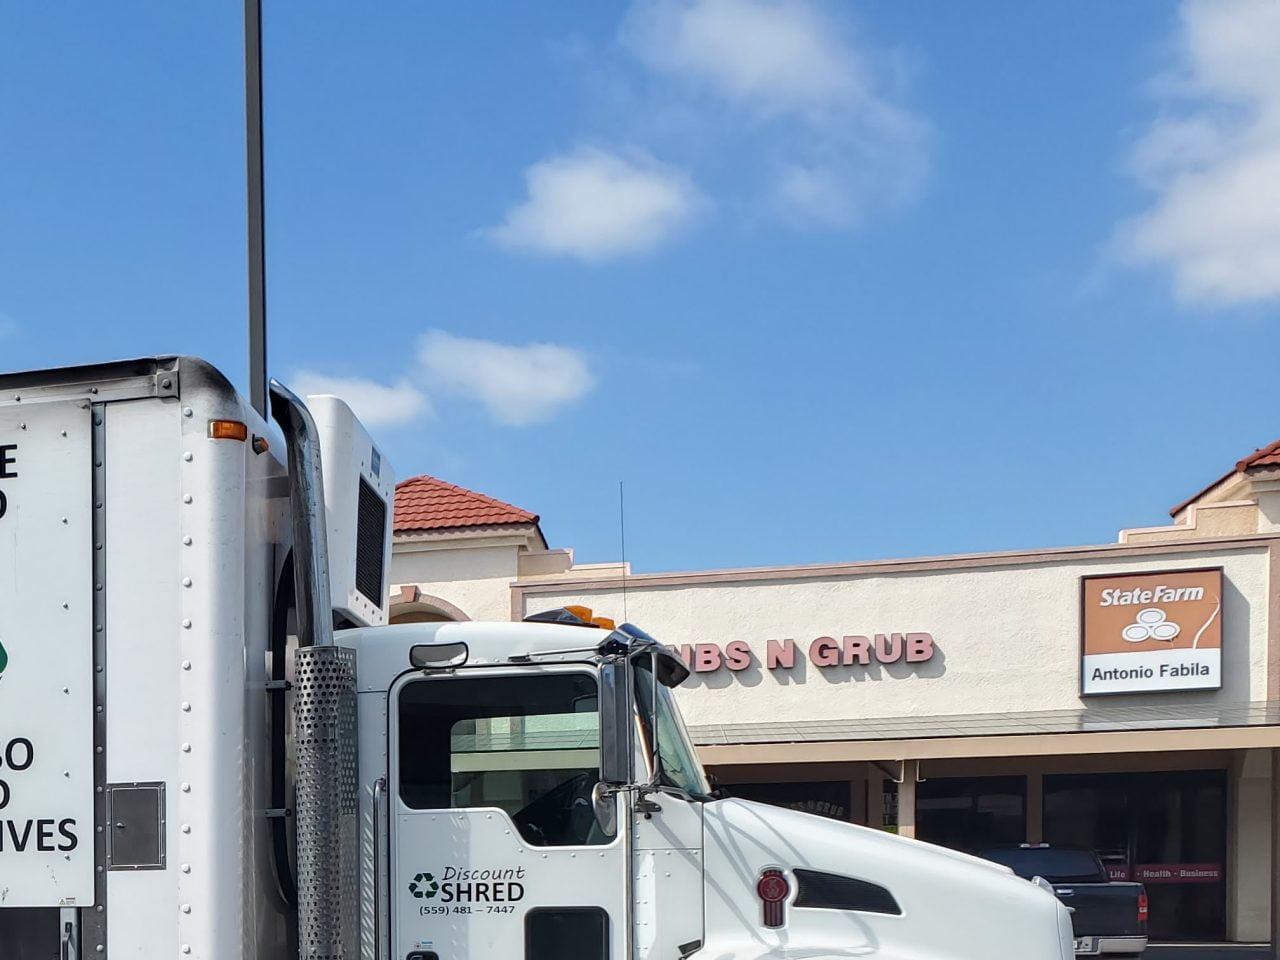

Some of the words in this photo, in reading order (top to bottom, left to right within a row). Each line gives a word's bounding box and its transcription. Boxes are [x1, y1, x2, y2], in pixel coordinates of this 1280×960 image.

[767, 638, 796, 669] N
[809, 632, 935, 668] GRUB
[1092, 665, 1154, 681] Antonio
[1160, 662, 1210, 678] Fabila
[442, 866, 526, 881] Discount
[1110, 870, 1126, 878] Life
[1143, 869, 1171, 878] Health
[1180, 869, 1218, 878] Business
[440, 882, 525, 903] SHRED
[419, 905, 450, 917] (559)
[452, 905, 473, 915] 481
[486, 905, 516, 914] 7447
